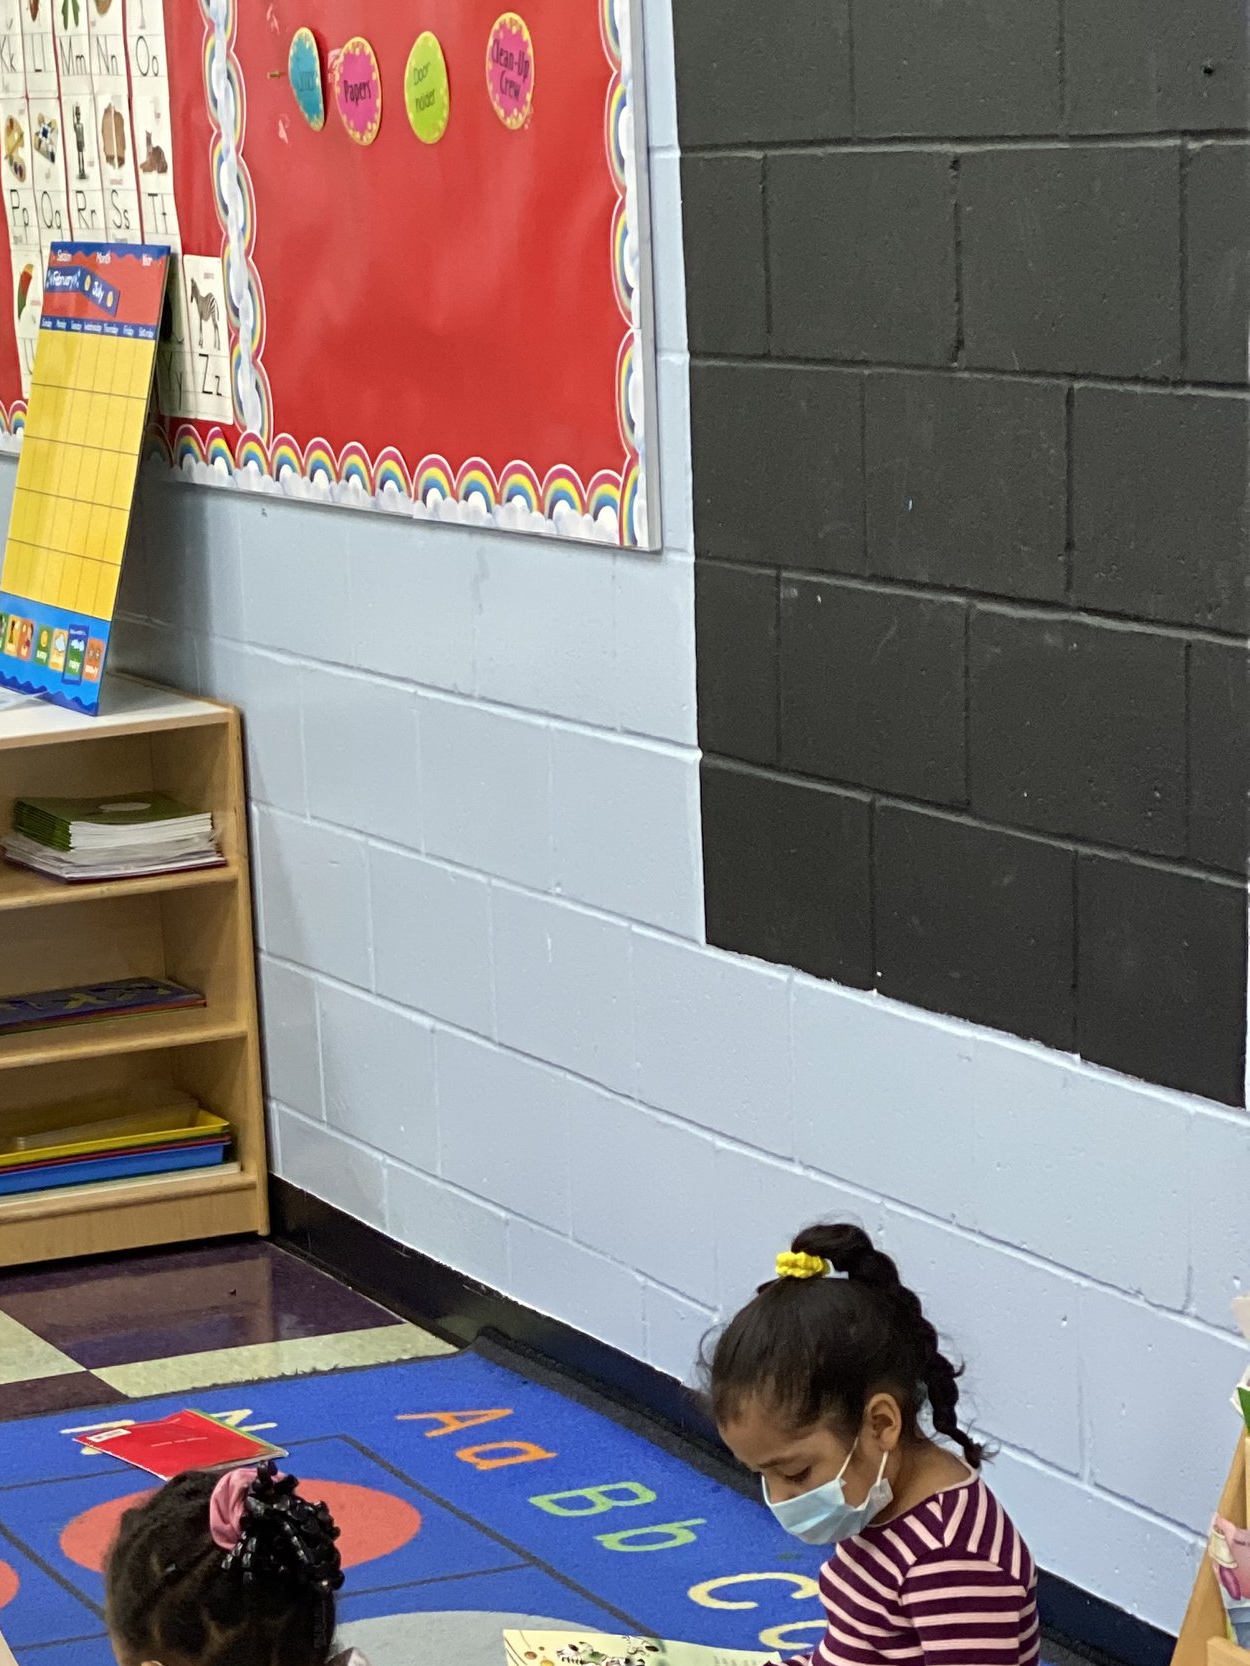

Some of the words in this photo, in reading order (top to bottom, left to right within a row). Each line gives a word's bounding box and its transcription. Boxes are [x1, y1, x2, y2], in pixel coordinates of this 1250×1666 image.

[59, 36, 88, 75] Mm
[96, 35, 119, 76] Nn
[135, 35, 160, 77] Oo
[343, 80, 372, 105] Papers
[500, 70, 521, 100] Crew
[75, 190, 97, 230] Rr
[111, 189, 131, 230] Ss
[91, 281, 105, 304] July
[198, 353, 223, 397] Zz
